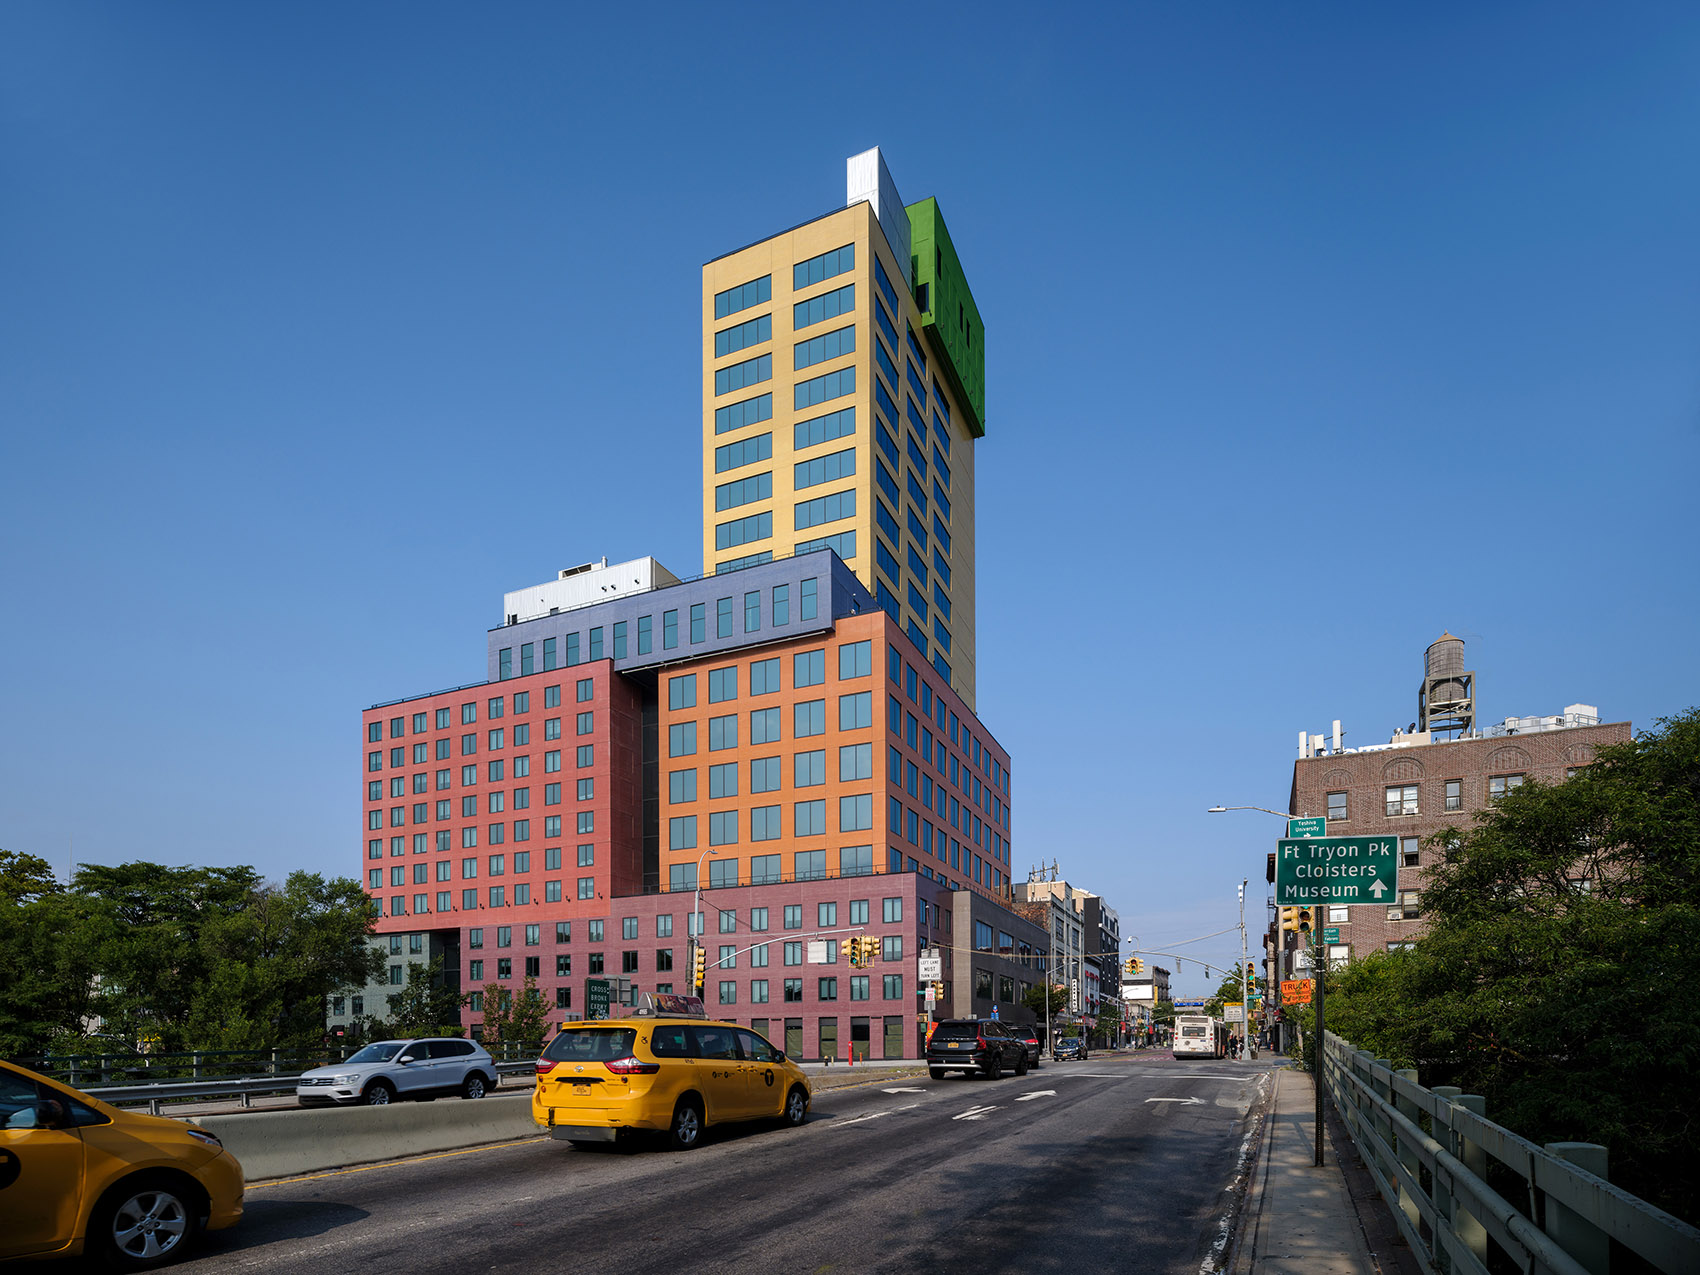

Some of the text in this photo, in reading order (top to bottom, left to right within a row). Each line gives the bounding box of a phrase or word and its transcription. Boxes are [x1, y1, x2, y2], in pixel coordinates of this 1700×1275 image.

[1284, 842, 1390, 861] Ft Tryon Pk
[1295, 863, 1377, 878] Cloisters
[1285, 885, 1359, 897] Museum
[591, 985, 607, 993] CROSS
